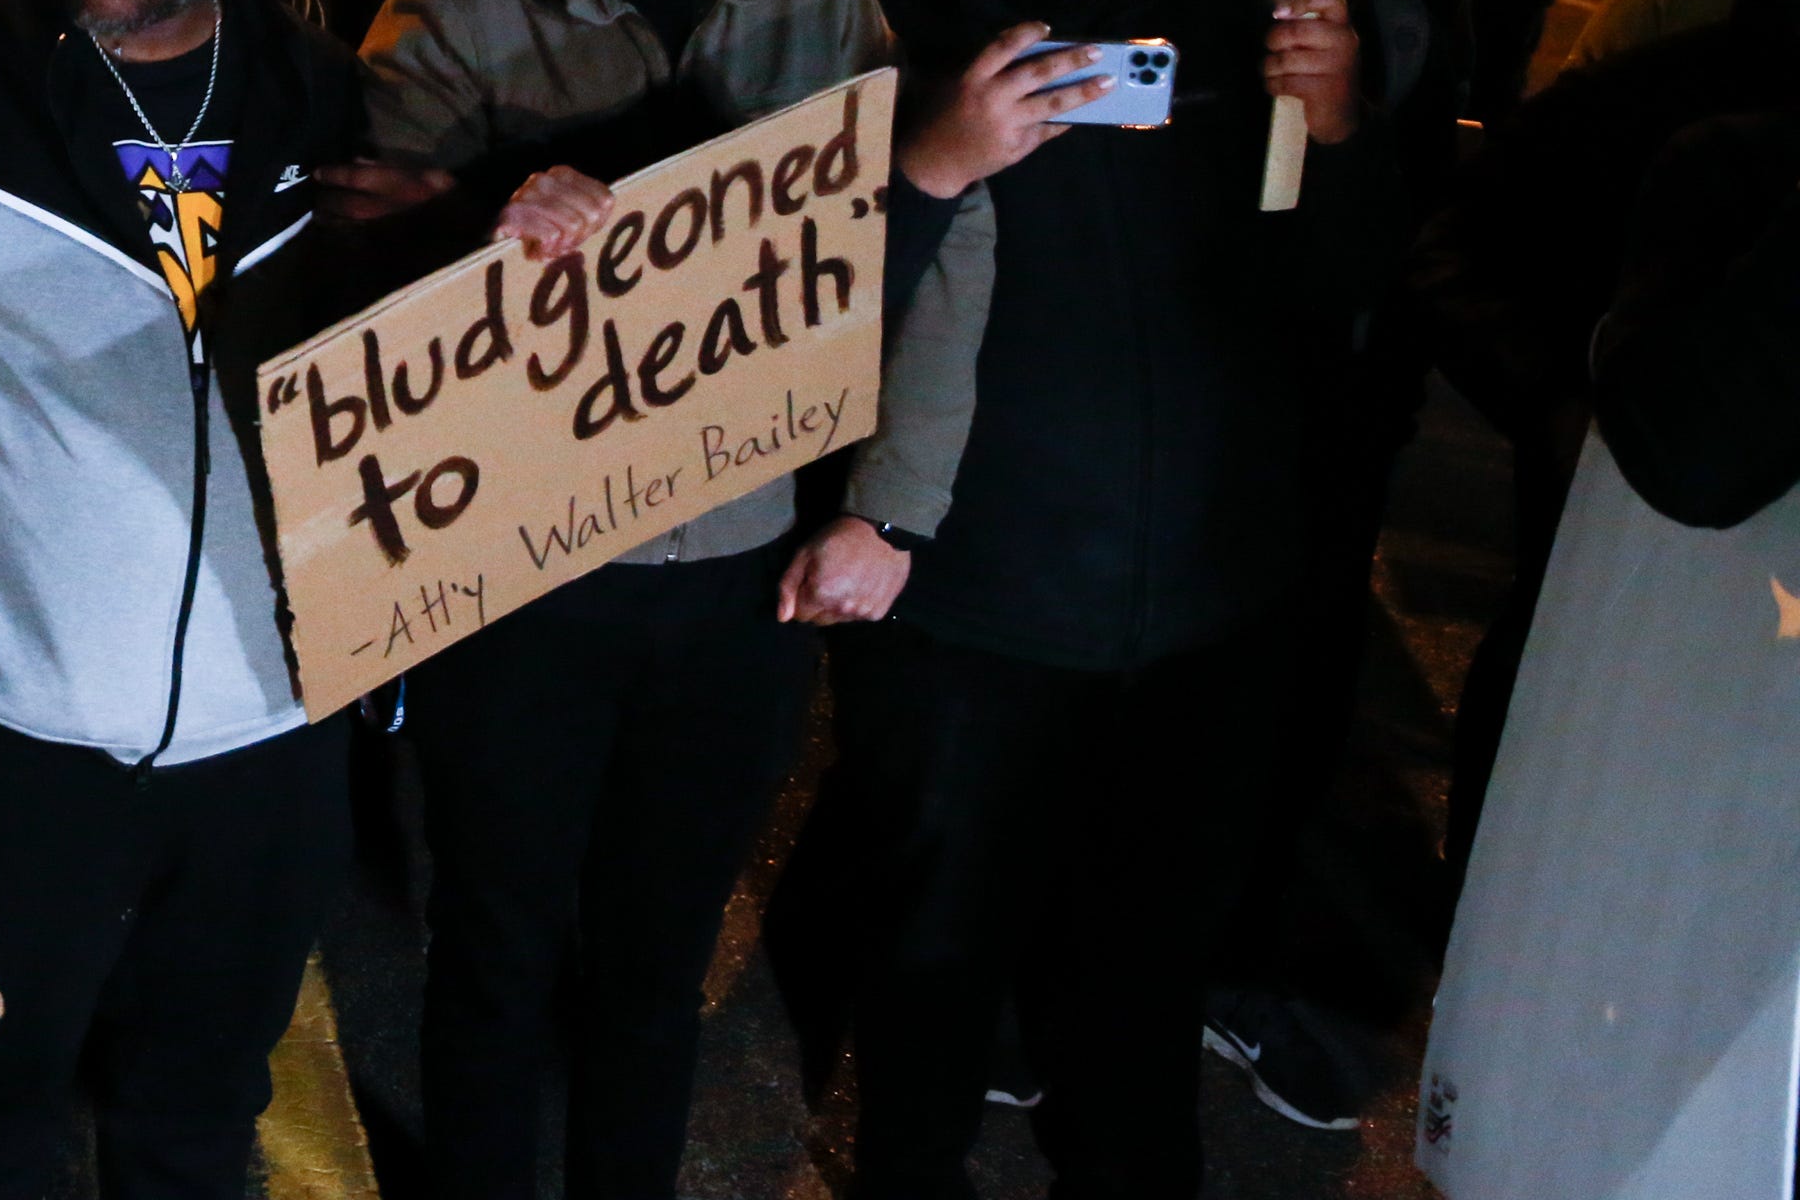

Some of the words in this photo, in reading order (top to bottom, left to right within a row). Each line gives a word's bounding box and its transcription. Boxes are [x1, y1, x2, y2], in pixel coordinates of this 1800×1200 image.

[349, 453, 480, 568] to
[518, 464, 683, 570] Walter
[700, 388, 849, 482] Bailey
